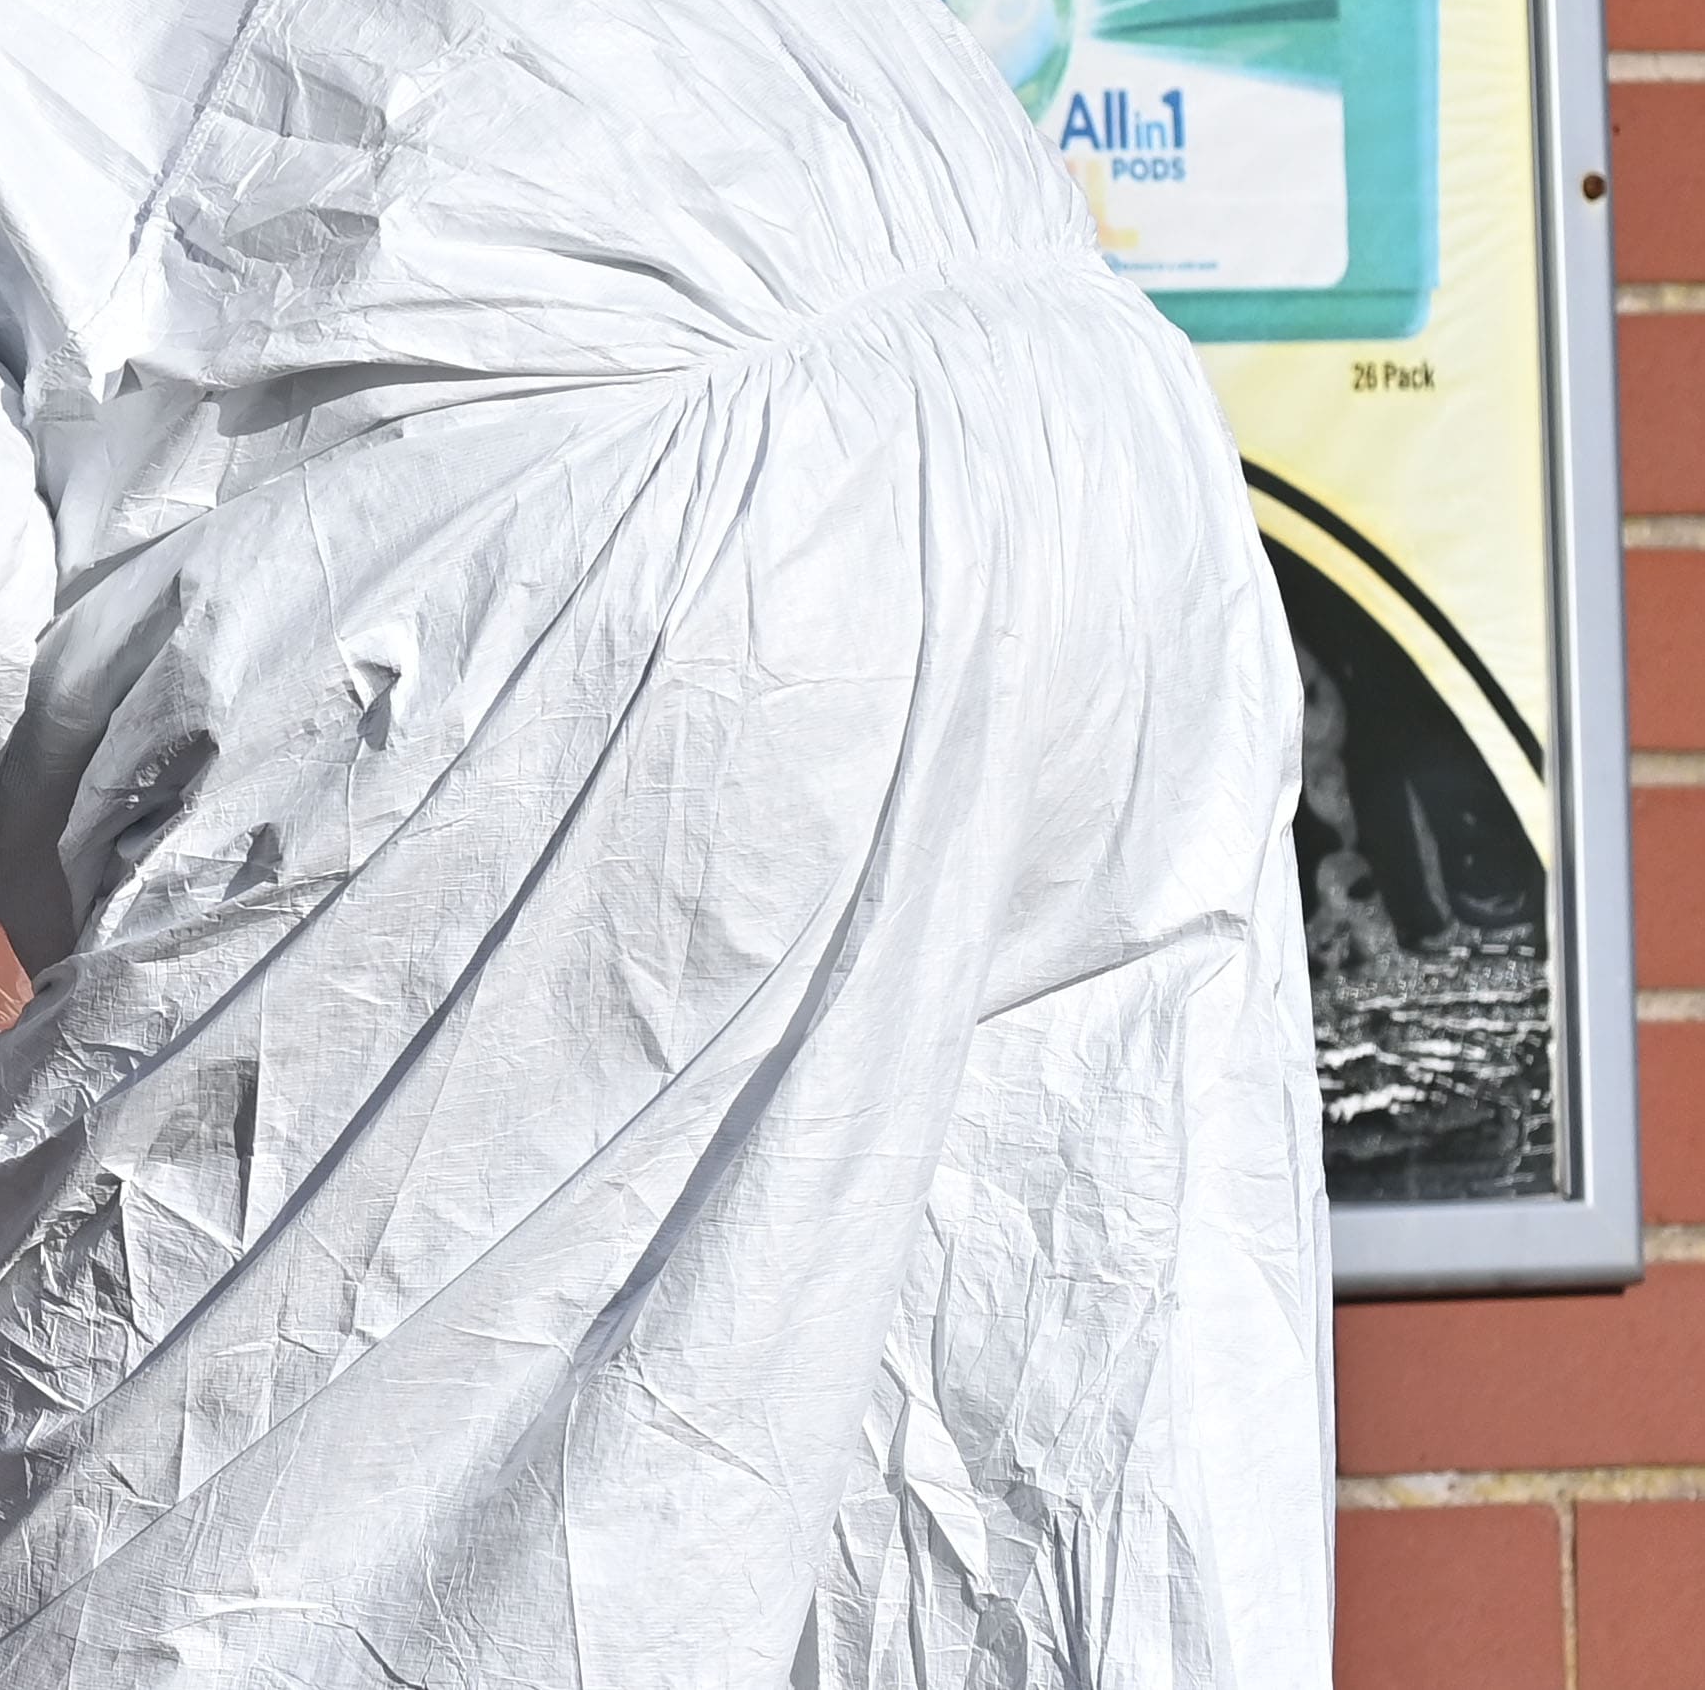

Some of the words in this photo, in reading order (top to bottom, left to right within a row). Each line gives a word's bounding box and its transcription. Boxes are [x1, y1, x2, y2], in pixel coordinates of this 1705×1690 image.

[1111, 157, 1187, 182] PODS
[1353, 361, 1378, 391] 26
[1383, 358, 1436, 392] Pack
